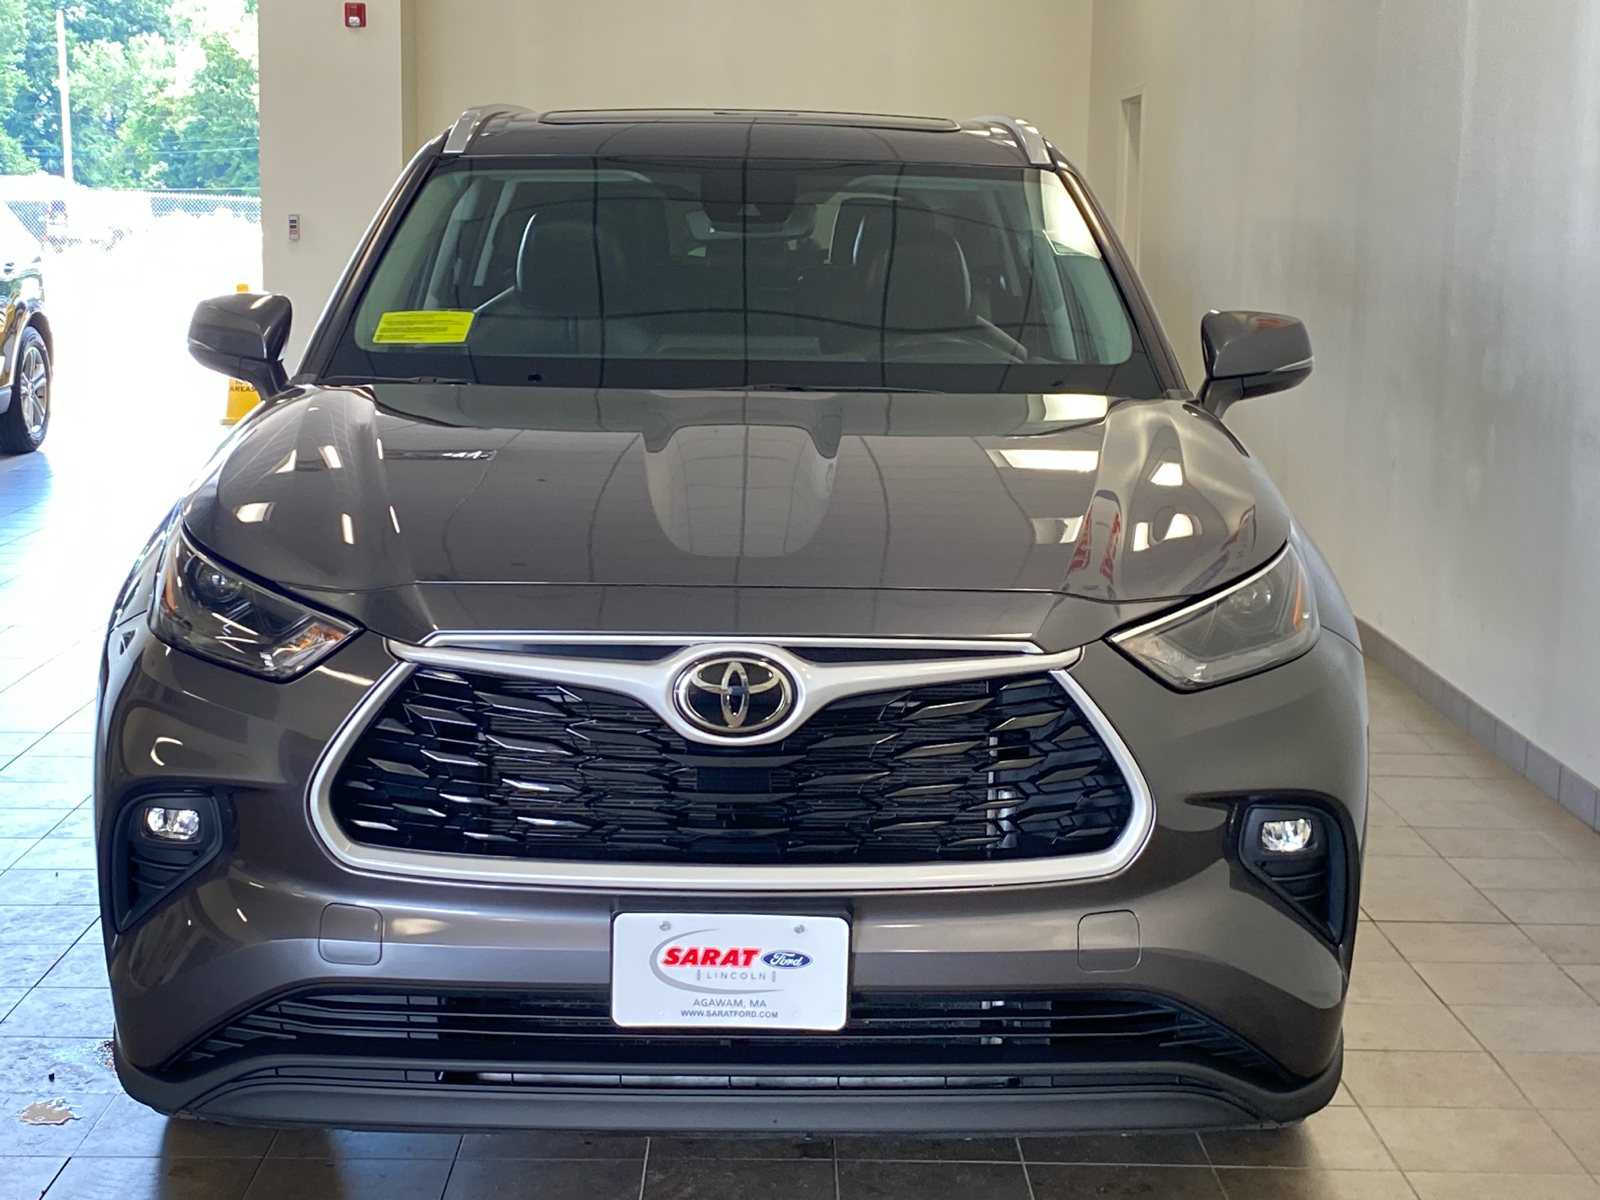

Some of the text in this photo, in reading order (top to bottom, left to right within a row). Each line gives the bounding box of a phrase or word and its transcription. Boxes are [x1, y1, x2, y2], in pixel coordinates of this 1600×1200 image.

[661, 947, 804, 967] SARAT Ford
[706, 971, 766, 980] LINCOLN
[693, 998, 767, 1009] AGAWAM, MA
[681, 1009, 779, 1018] WWW.SARATFORD.COM
